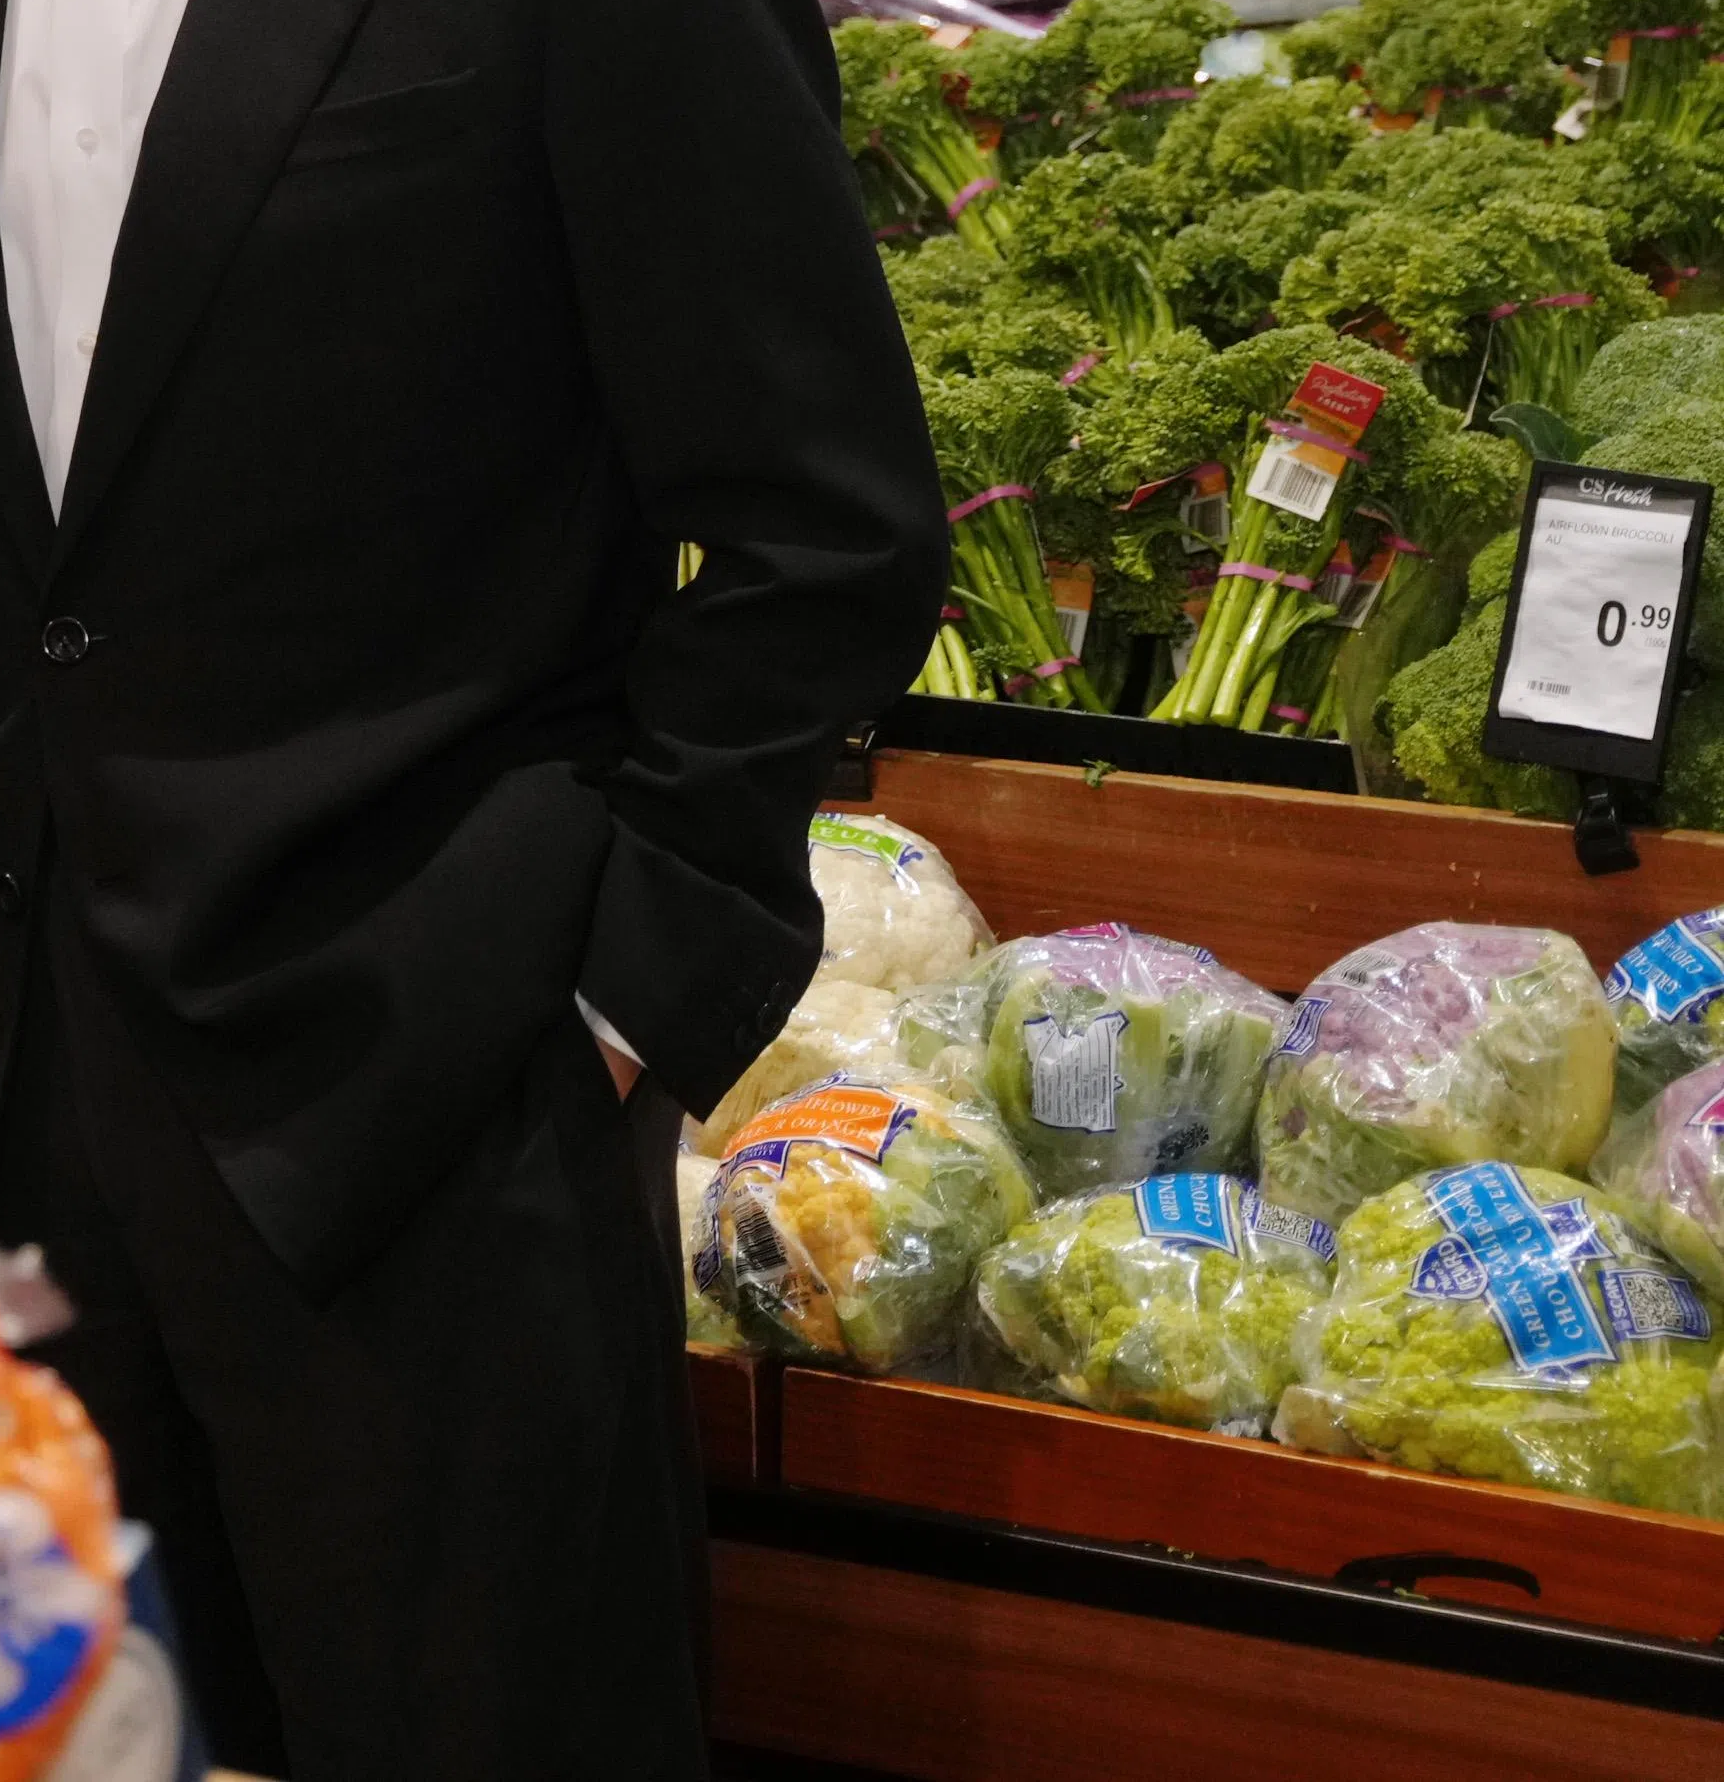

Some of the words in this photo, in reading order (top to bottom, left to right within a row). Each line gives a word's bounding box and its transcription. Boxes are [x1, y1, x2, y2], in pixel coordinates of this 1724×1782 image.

[1579, 477, 1605, 494] CS
[1604, 482, 1653, 506] Fresh
[1545, 534, 1563, 545] AU
[1548, 520, 1609, 536] AIRFLOWN
[1611, 526, 1674, 544] BROCCOLI
[1597, 600, 1671, 647] 0.99
[1505, 1281, 1550, 1349] GREEN
[1606, 1278, 1629, 1320] SCAN
